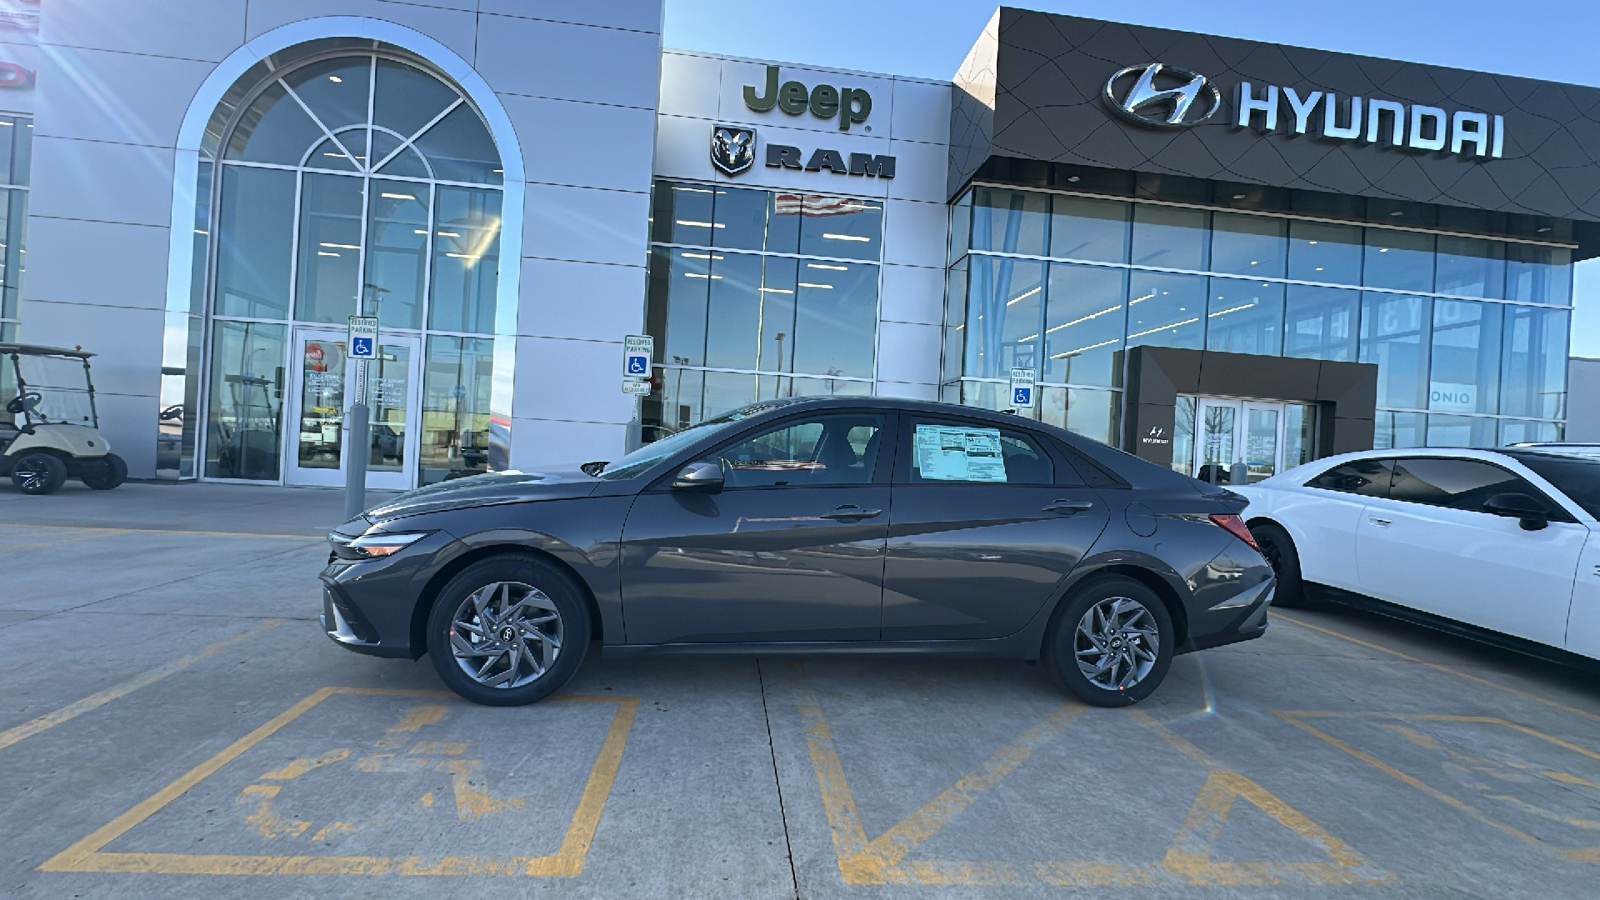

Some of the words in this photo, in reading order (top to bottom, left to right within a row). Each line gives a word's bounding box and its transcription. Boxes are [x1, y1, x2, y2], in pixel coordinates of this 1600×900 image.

[743, 65, 872, 131] Jeep
[1237, 81, 1505, 159] HYUNDAI
[765, 143, 897, 179] RAM
[351, 319, 377, 327] RESERVED
[627, 338, 651, 346] RESERVED
[1431, 391, 1470, 404] ONIQ
[1142, 437, 1169, 445] HYUNDAI
